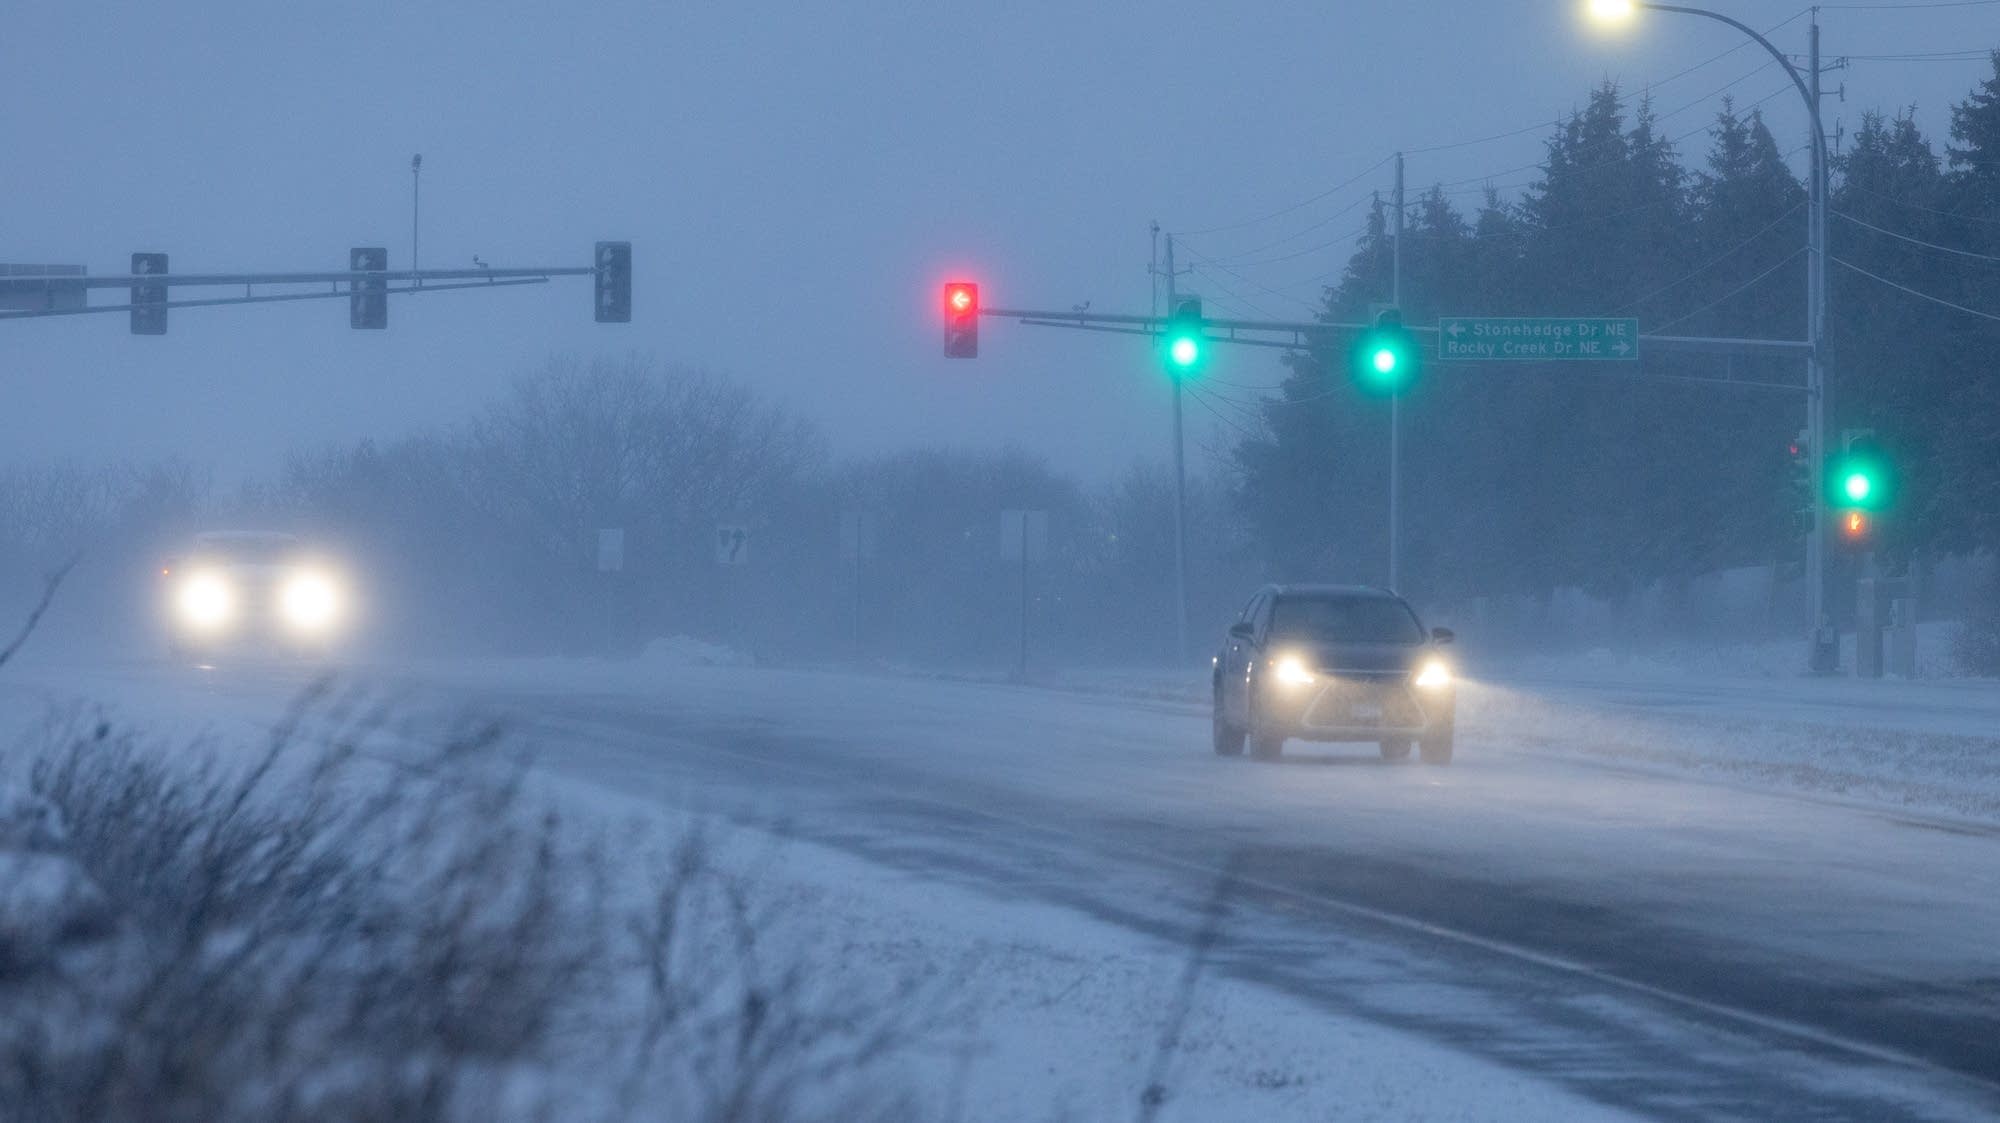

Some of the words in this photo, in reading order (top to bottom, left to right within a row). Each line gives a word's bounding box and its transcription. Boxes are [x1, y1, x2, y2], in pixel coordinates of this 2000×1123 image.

[1473, 323, 1572, 339] Stonehedge
[1578, 323, 1598, 336] Dr
[1605, 323, 1626, 336] NE
[1448, 341, 1495, 357] Rocky
[1503, 341, 1546, 354] Creek
[1554, 341, 1573, 354] Dr
[1580, 341, 1600, 354] NE
